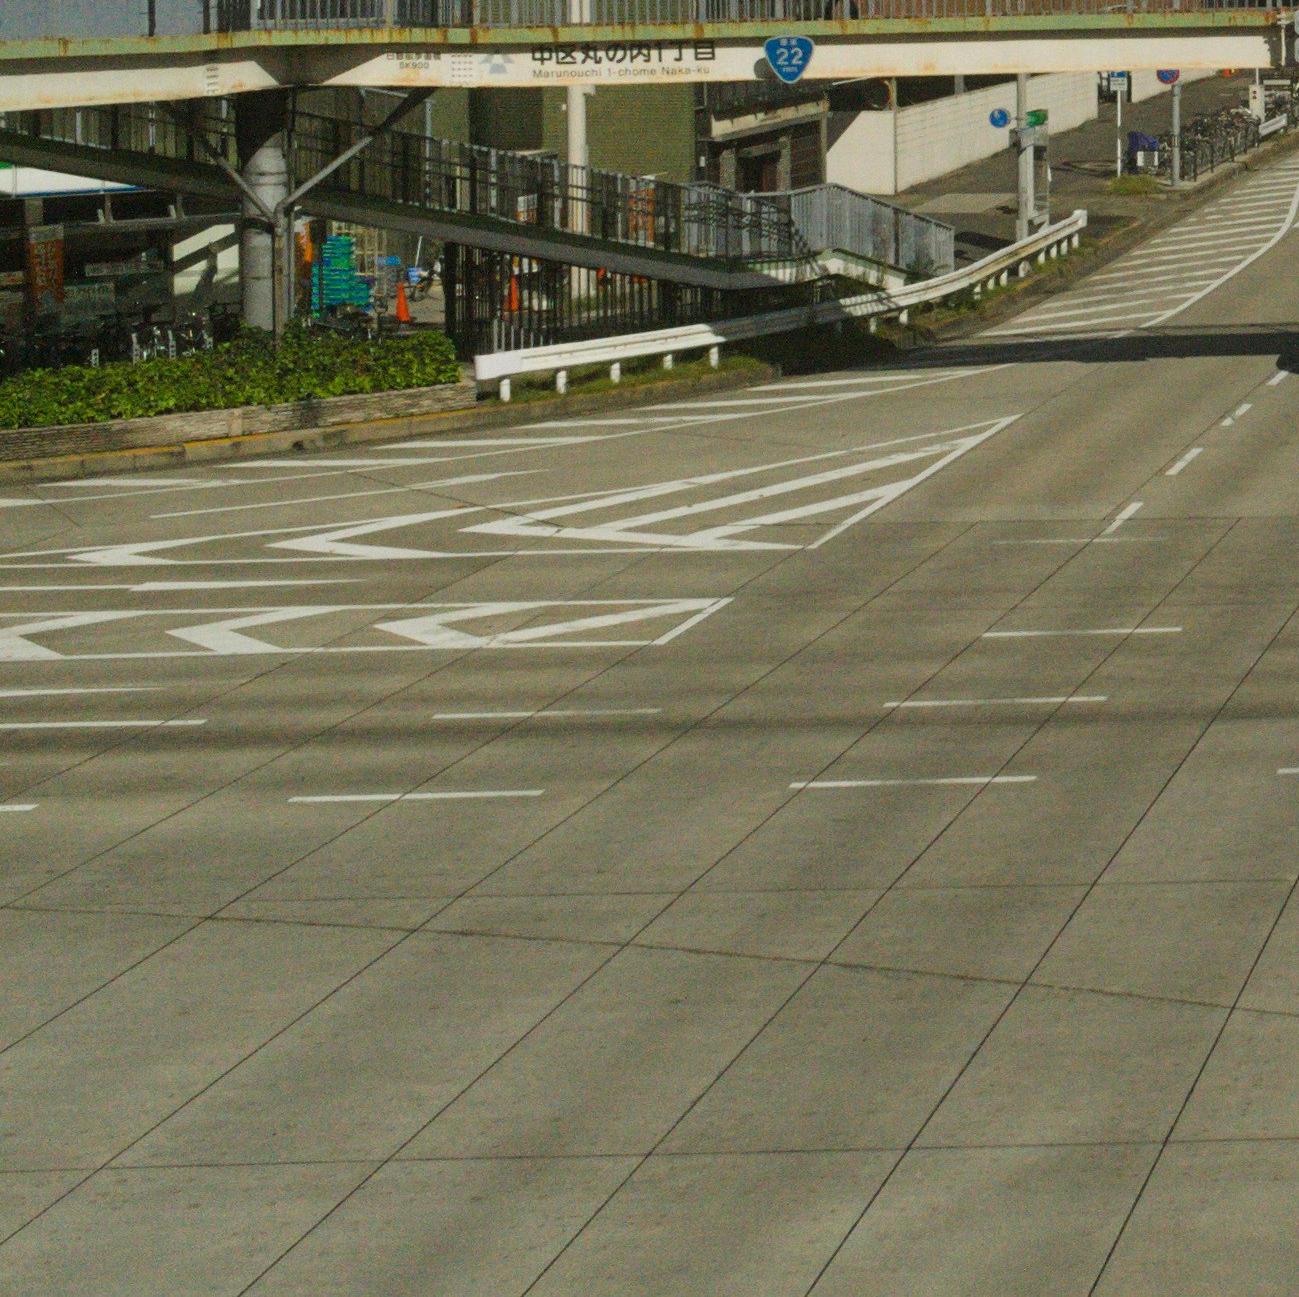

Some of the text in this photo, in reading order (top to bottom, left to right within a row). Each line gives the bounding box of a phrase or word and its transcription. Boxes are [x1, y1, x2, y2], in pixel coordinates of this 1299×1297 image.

[531, 41, 716, 66] 中区丸の内1丁目
[776, 47, 804, 66] 22
[533, 66, 710, 79] Marunouchi 1-chome Naka-ku
